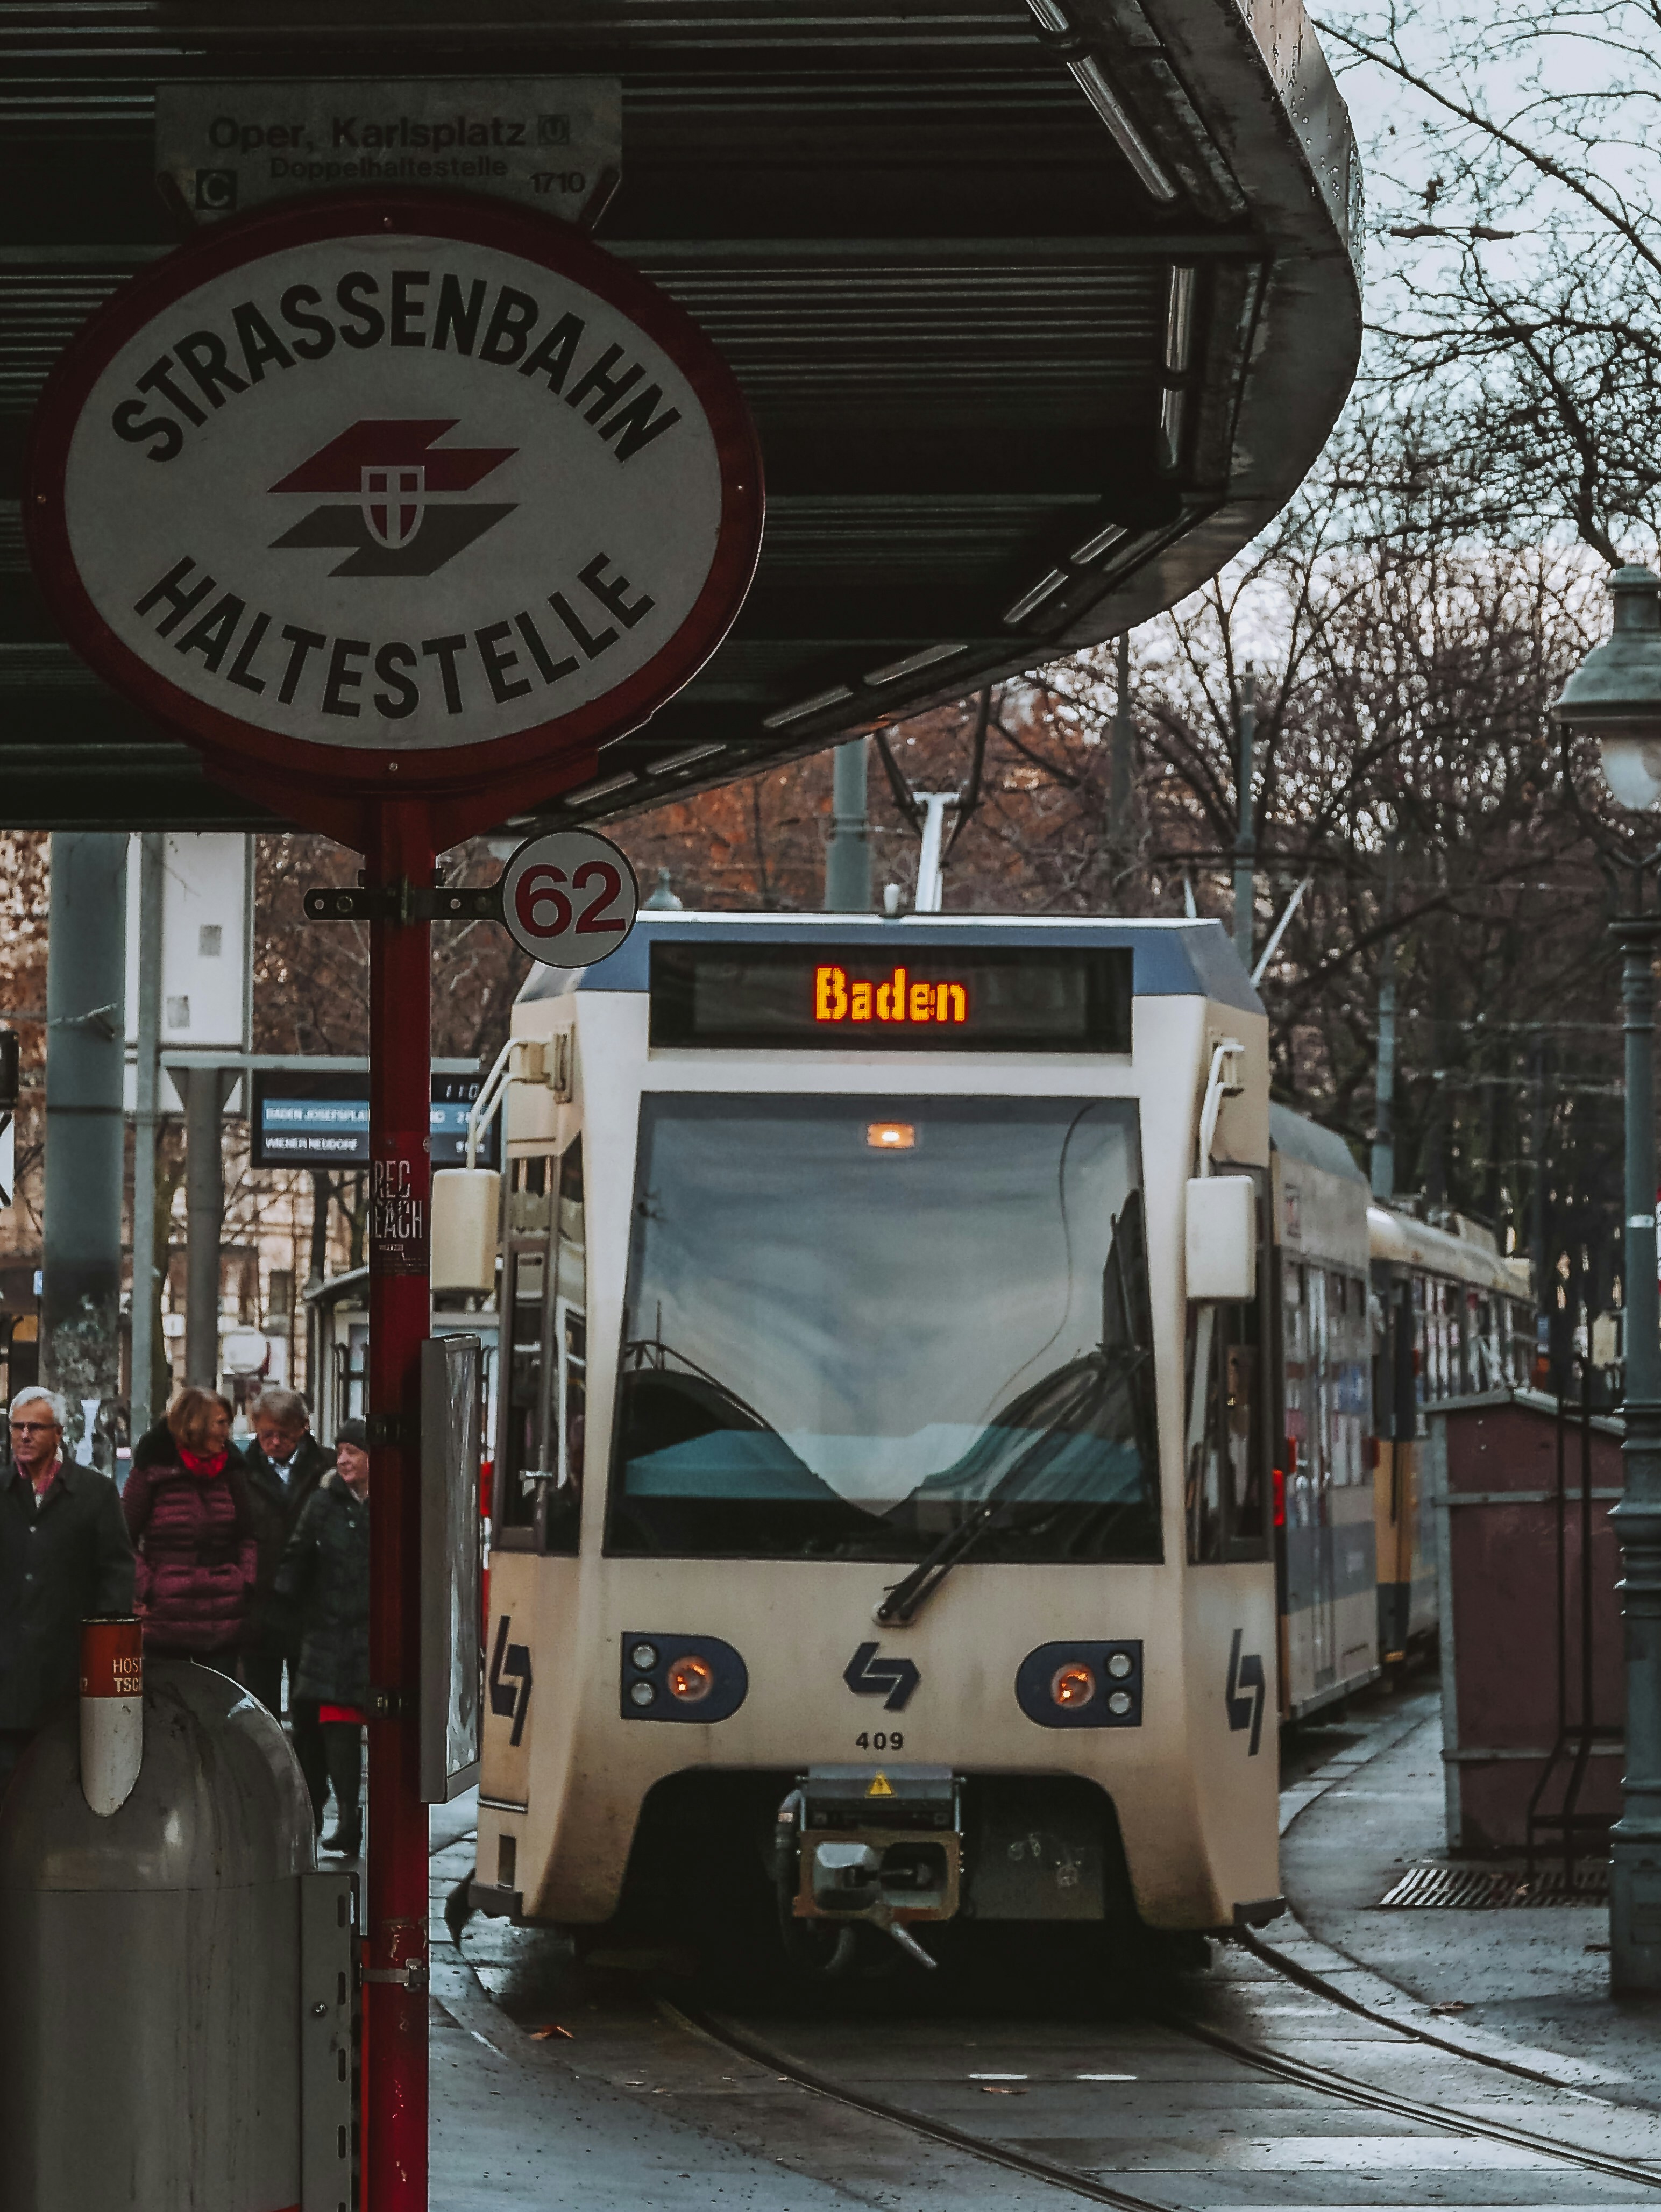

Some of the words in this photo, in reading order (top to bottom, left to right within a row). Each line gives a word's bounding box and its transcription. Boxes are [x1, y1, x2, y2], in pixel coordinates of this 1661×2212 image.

[209, 117, 316, 152] Oper,
[333, 116, 526, 153] Karlsplatz
[271, 156, 507, 181] Doppelhaltestelle
[529, 171, 585, 194] 1710
[201, 172, 230, 207] C
[112, 271, 682, 463] STRASSENBAHN
[133, 552, 655, 718] HALTESTELLE
[515, 861, 626, 938] 62
[815, 966, 967, 1022] Baden
[855, 1732, 904, 1750] 409
